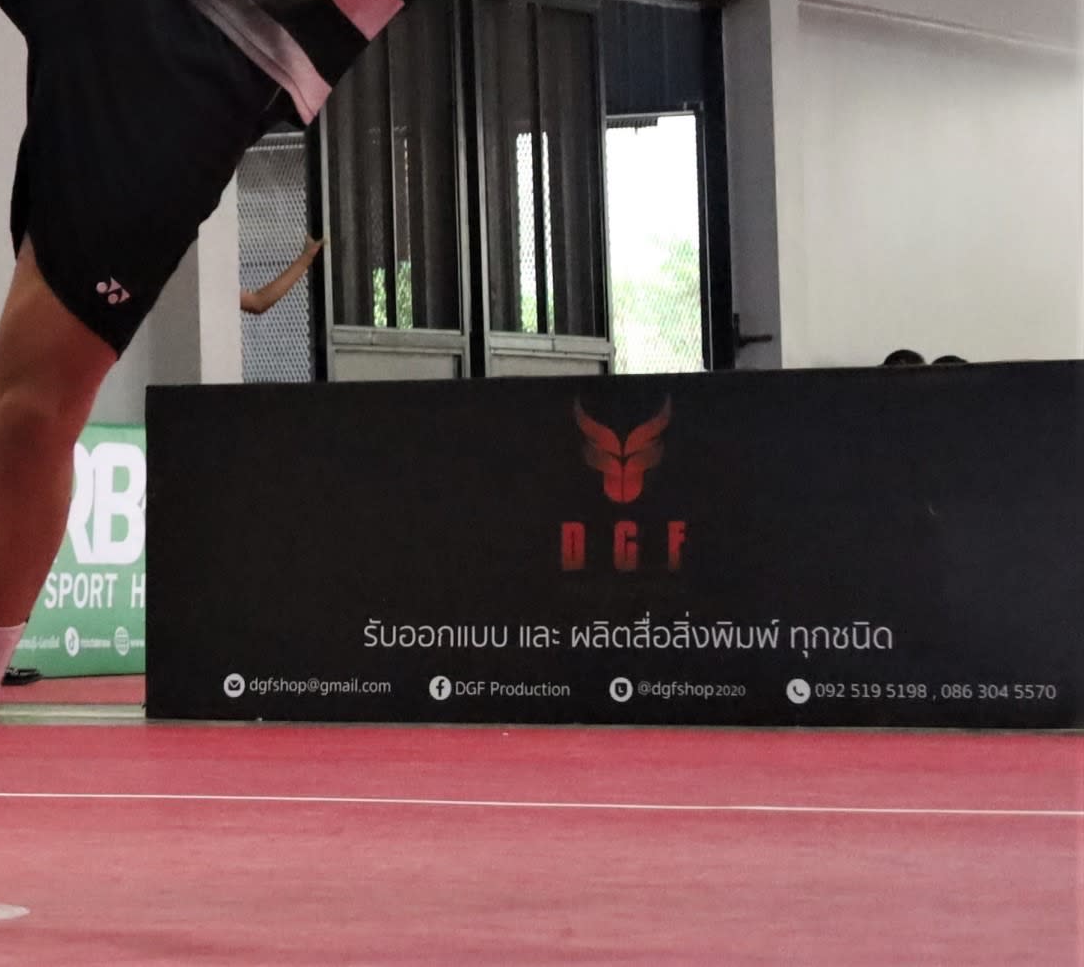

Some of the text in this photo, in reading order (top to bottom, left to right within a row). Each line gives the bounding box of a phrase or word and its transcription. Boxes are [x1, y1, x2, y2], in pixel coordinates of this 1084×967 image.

[44, 572, 146, 610] SPORT H
[363, 610, 894, 659] รับออกแบบ และ ผลิตสื่อสิ่งพิมพ์ ทุกชนิด
[249, 676, 392, 696] dgfshop@gmail.com
[454, 680, 571, 698] DGF Production
[815, 682, 846, 699] 092
[851, 683, 882, 699] 519
[940, 683, 973, 700] 086
[978, 684, 1009, 700] 304
[1014, 684, 1057, 701] 5570
